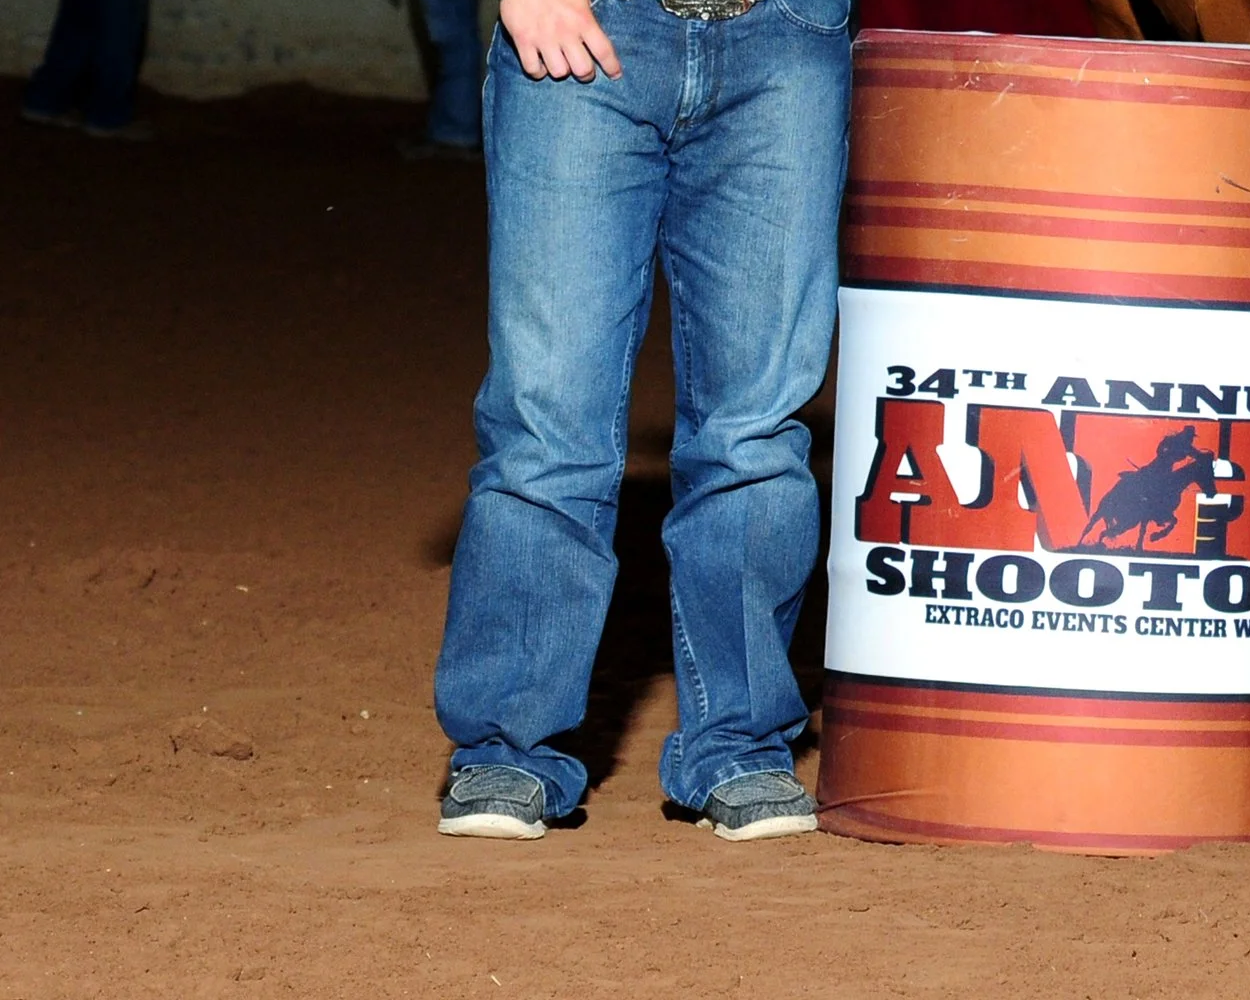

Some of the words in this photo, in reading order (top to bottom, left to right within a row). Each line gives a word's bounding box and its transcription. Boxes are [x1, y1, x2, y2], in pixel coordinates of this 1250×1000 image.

[885, 365, 1027, 399] 34TH
[925, 603, 1025, 629] EXTRACO
[1031, 610, 1128, 635] EVENTS
[1135, 616, 1228, 639] CENTER
